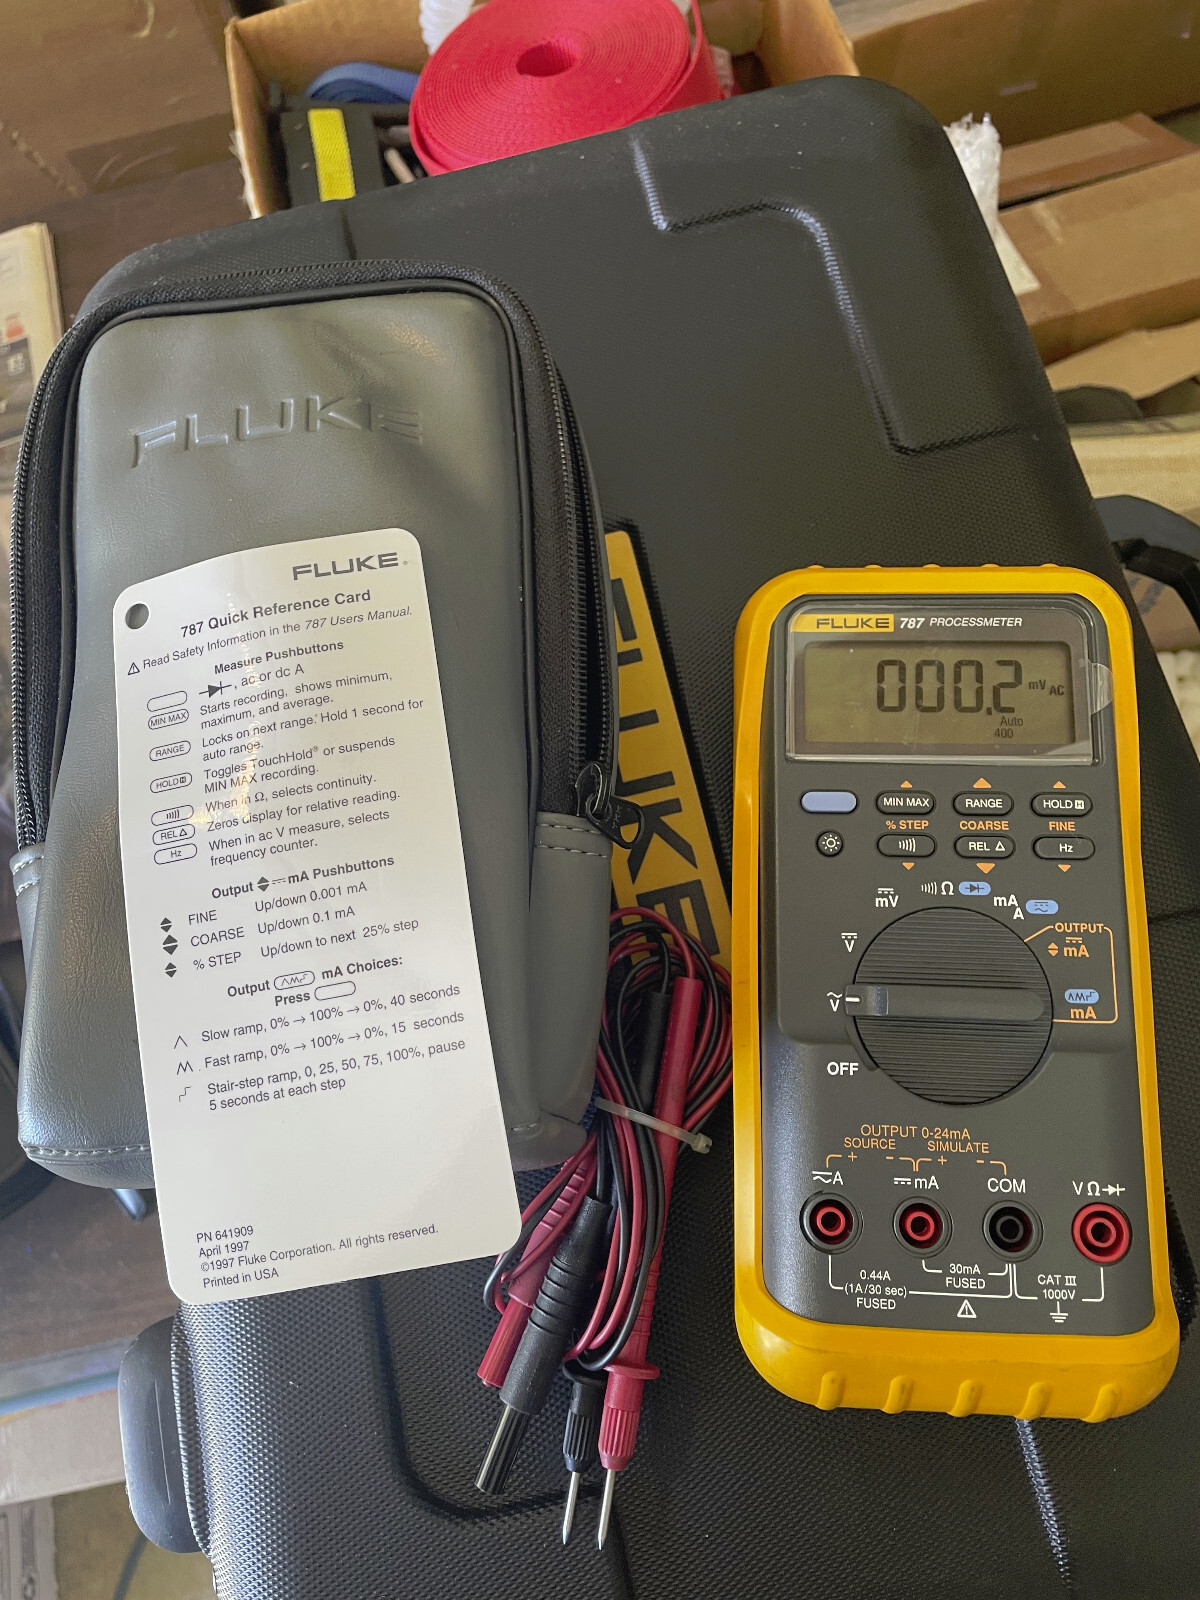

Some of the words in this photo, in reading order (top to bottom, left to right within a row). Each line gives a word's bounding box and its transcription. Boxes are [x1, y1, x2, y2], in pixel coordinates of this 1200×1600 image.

[126, 394, 424, 468] FLUKE
[180, 620, 204, 638] 787
[208, 609, 249, 630] Quick
[252, 597, 330, 619] Reference
[334, 589, 371, 605] Card
[816, 618, 890, 629] FLUKE
[899, 617, 925, 629] 787
[929, 616, 1023, 627] PROCESSMETER
[142, 653, 170, 670] Read
[172, 645, 205, 661] Safety
[206, 630, 266, 652] Information
[282, 622, 302, 634] the
[305, 617, 327, 630] 787
[330, 614, 364, 626] Users
[367, 605, 412, 621] Manual.
[214, 656, 262, 675] Measure
[265, 642, 344, 662] Pushbuttons
[200, 701, 231, 716] Starts
[233, 688, 288, 707] recording,
[294, 680, 332, 694] shows
[335, 672, 392, 688] minimum,
[876, 659, 1022, 716] 000.2
[1028, 679, 1046, 690] mV
[1049, 685, 1065, 696] AC
[150, 716, 166, 727] MIN
[168, 712, 186, 723] MAX
[200, 710, 255, 730] maximum,
[258, 701, 280, 716] and
[283, 695, 334, 710] average.
[202, 733, 234, 748] Locks
[252, 721, 277, 736] next
[280, 716, 317, 730] range.
[320, 708, 348, 723] Hold
[362, 700, 404, 718] second
[406, 698, 424, 712] for
[1000, 715, 1024, 727] Auto
[155, 744, 184, 758] RANGE
[202, 749, 226, 762] auto
[203, 763, 247, 780] Toggles
[338, 736, 396, 754] suspends
[204, 780, 227, 794] MIN
[260, 764, 319, 782] recording.
[271, 784, 314, 799] selects
[316, 774, 377, 792] continuity.
[883, 797, 904, 807] MIN
[906, 798, 930, 808] MAX
[965, 798, 1003, 808] RANGE
[1043, 800, 1073, 809] HOLD
[206, 818, 239, 832] Zeros
[286, 805, 303, 816] for
[306, 798, 349, 813] relative
[352, 790, 400, 805] reading.
[208, 837, 242, 852] When
[288, 819, 344, 836] measure,
[348, 810, 390, 826] selects
[886, 820, 896, 830] %
[899, 820, 929, 830] STEP
[959, 820, 1009, 831] COARSE
[1048, 821, 1076, 831] FINE
[160, 830, 178, 840] REL
[210, 847, 267, 867] frequency
[269, 838, 318, 855] counter.
[968, 841, 990, 851] REL
[1059, 843, 1073, 853] Hz
[170, 850, 182, 858] Hz
[211, 881, 254, 899] Output
[288, 870, 310, 884] mA
[312, 857, 395, 880] Pushbuttons
[254, 894, 307, 913] Up/down
[309, 885, 342, 902] 0.001
[346, 881, 368, 895] mA
[875, 895, 899, 908] mV
[993, 894, 1018, 907] mA
[188, 909, 218, 926] FINE
[257, 916, 310, 935] Up/down
[312, 910, 330, 924] 0.1
[334, 905, 356, 920] mA
[1054, 922, 1103, 934] OUTPUT
[190, 926, 245, 947] COARSE
[260, 940, 313, 959] Up/down
[330, 929, 357, 944] next
[362, 922, 390, 938] 25%
[393, 920, 419, 932] step
[1063, 945, 1089, 957] mA
[208, 951, 242, 968] STEP
[227, 979, 271, 998] Output
[321, 965, 344, 980] mA
[346, 956, 403, 975] Choices:
[274, 992, 311, 1007] Press
[201, 1028, 230, 1042] Slow
[233, 1023, 267, 1037] ramp,
[270, 1016, 290, 1030] 0%
[309, 1006, 344, 1022] 100%
[363, 998, 387, 1012] 0%,
[390, 994, 406, 1007] 40
[409, 984, 461, 1004] seconds
[1070, 1007, 1097, 1020] mA
[204, 1054, 231, 1069] Fast
[233, 1050, 267, 1064] ramp,
[270, 1042, 290, 1057] 0%
[310, 1032, 344, 1049] 100%
[364, 1025, 388, 1039] 0%,
[391, 1021, 406, 1034] 15
[413, 1011, 465, 1030] seconds
[207, 1076, 264, 1095] Stair-step
[267, 1070, 302, 1084] ramp,
[319, 1061, 338, 1075] 25,
[341, 1057, 361, 1071] 50,
[363, 1053, 383, 1067] 75,
[386, 1046, 425, 1062] 100%,
[428, 1040, 466, 1058] pause
[827, 1062, 858, 1076] OFF
[220, 1090, 270, 1109] seconds
[288, 1082, 317, 1097] each
[320, 1078, 346, 1091] step
[860, 1124, 918, 1139] OUTPUT
[921, 1127, 970, 1140] 0-24mA
[843, 1137, 896, 1150] SOURCE
[927, 1140, 990, 1154] SIMULATE
[914, 1175, 939, 1190] mA
[987, 1178, 1026, 1193] COM
[196, 1231, 212, 1244] PN
[214, 1225, 254, 1241] 641909
[198, 1244, 222, 1259] April
[224, 1240, 250, 1254] 1997
[237, 1253, 267, 1267] Fluke
[269, 1243, 336, 1261] Corporation.
[338, 1237, 352, 1250] All
[355, 1234, 385, 1248] rights
[388, 1223, 439, 1241] reserved.
[859, 1270, 891, 1281] 0.44A
[949, 1264, 981, 1275] 30mA
[202, 1273, 240, 1289] Printed
[254, 1267, 280, 1281] USA
[945, 1277, 986, 1290] FUSED
[1037, 1275, 1062, 1285] CAT
[1041, 1289, 1076, 1300] 1000V
[856, 1297, 896, 1310] FUSED
